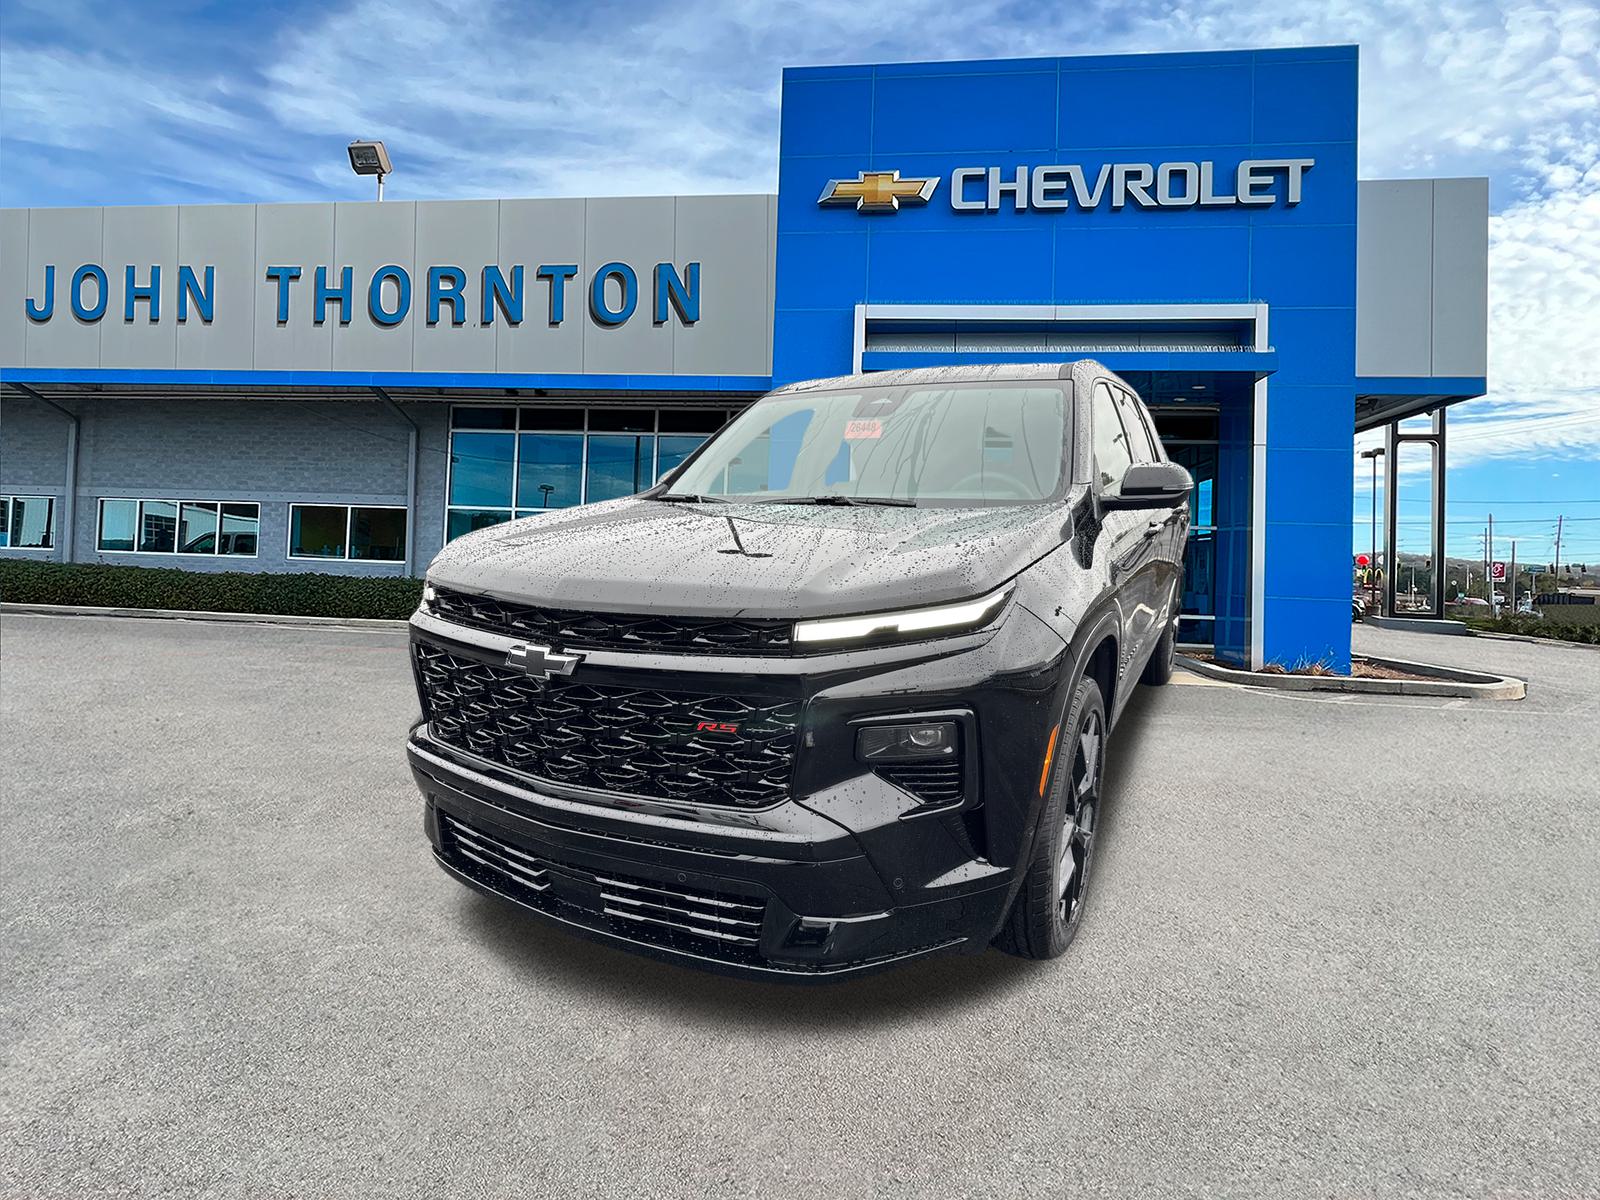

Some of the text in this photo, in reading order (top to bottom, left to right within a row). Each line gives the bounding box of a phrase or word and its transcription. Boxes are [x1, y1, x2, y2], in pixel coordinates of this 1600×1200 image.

[951, 158, 1315, 212] CHEVROLET
[25, 261, 702, 328] JOHN THORNTON
[696, 721, 738, 733] RS
